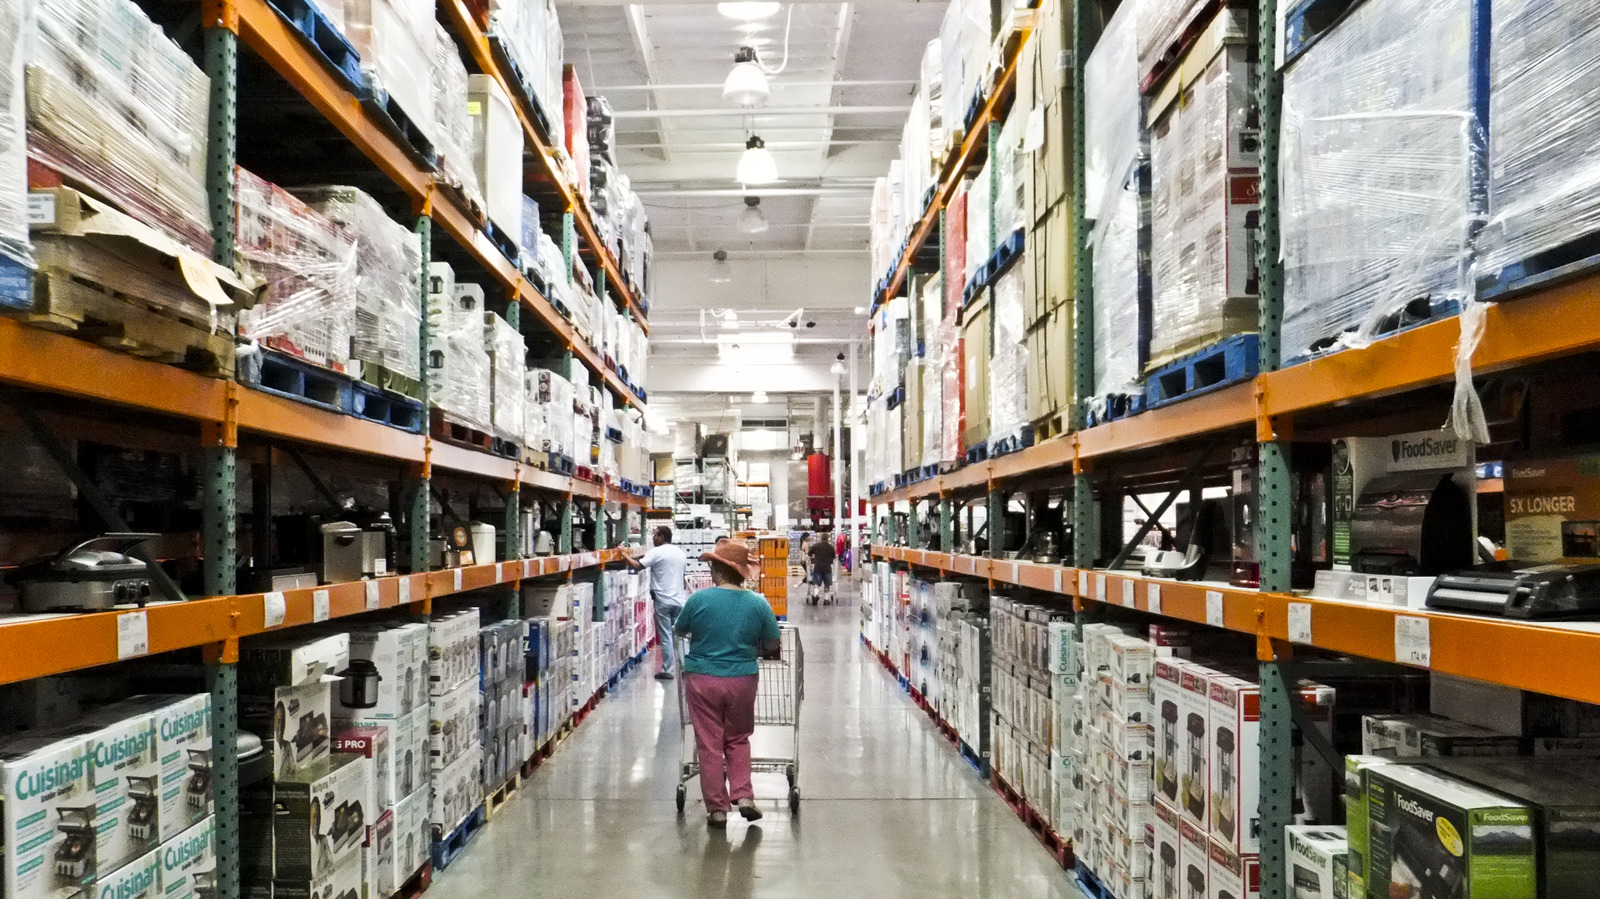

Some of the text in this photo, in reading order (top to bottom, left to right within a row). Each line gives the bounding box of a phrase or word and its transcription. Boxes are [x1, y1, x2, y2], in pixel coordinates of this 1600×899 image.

[1401, 438, 1458, 458] FoodSaver
[1512, 467, 1546, 478] FoodSaver
[1527, 496, 1576, 513] LONGER
[1059, 629, 1068, 672] Cuisinart
[161, 705, 211, 742] Cuisinart
[1372, 722, 1401, 741] FoodSaver
[95, 726, 157, 769] Cuisinart
[344, 740, 366, 749] PRO
[15, 750, 96, 800] Cuisinart
[1397, 794, 1435, 822] FoodSaver
[1483, 813, 1528, 822] FoodSaver
[164, 823, 216, 871] Cuisinart
[1295, 836, 1327, 868] FoodSaver
[101, 857, 163, 899] Cuisinart
